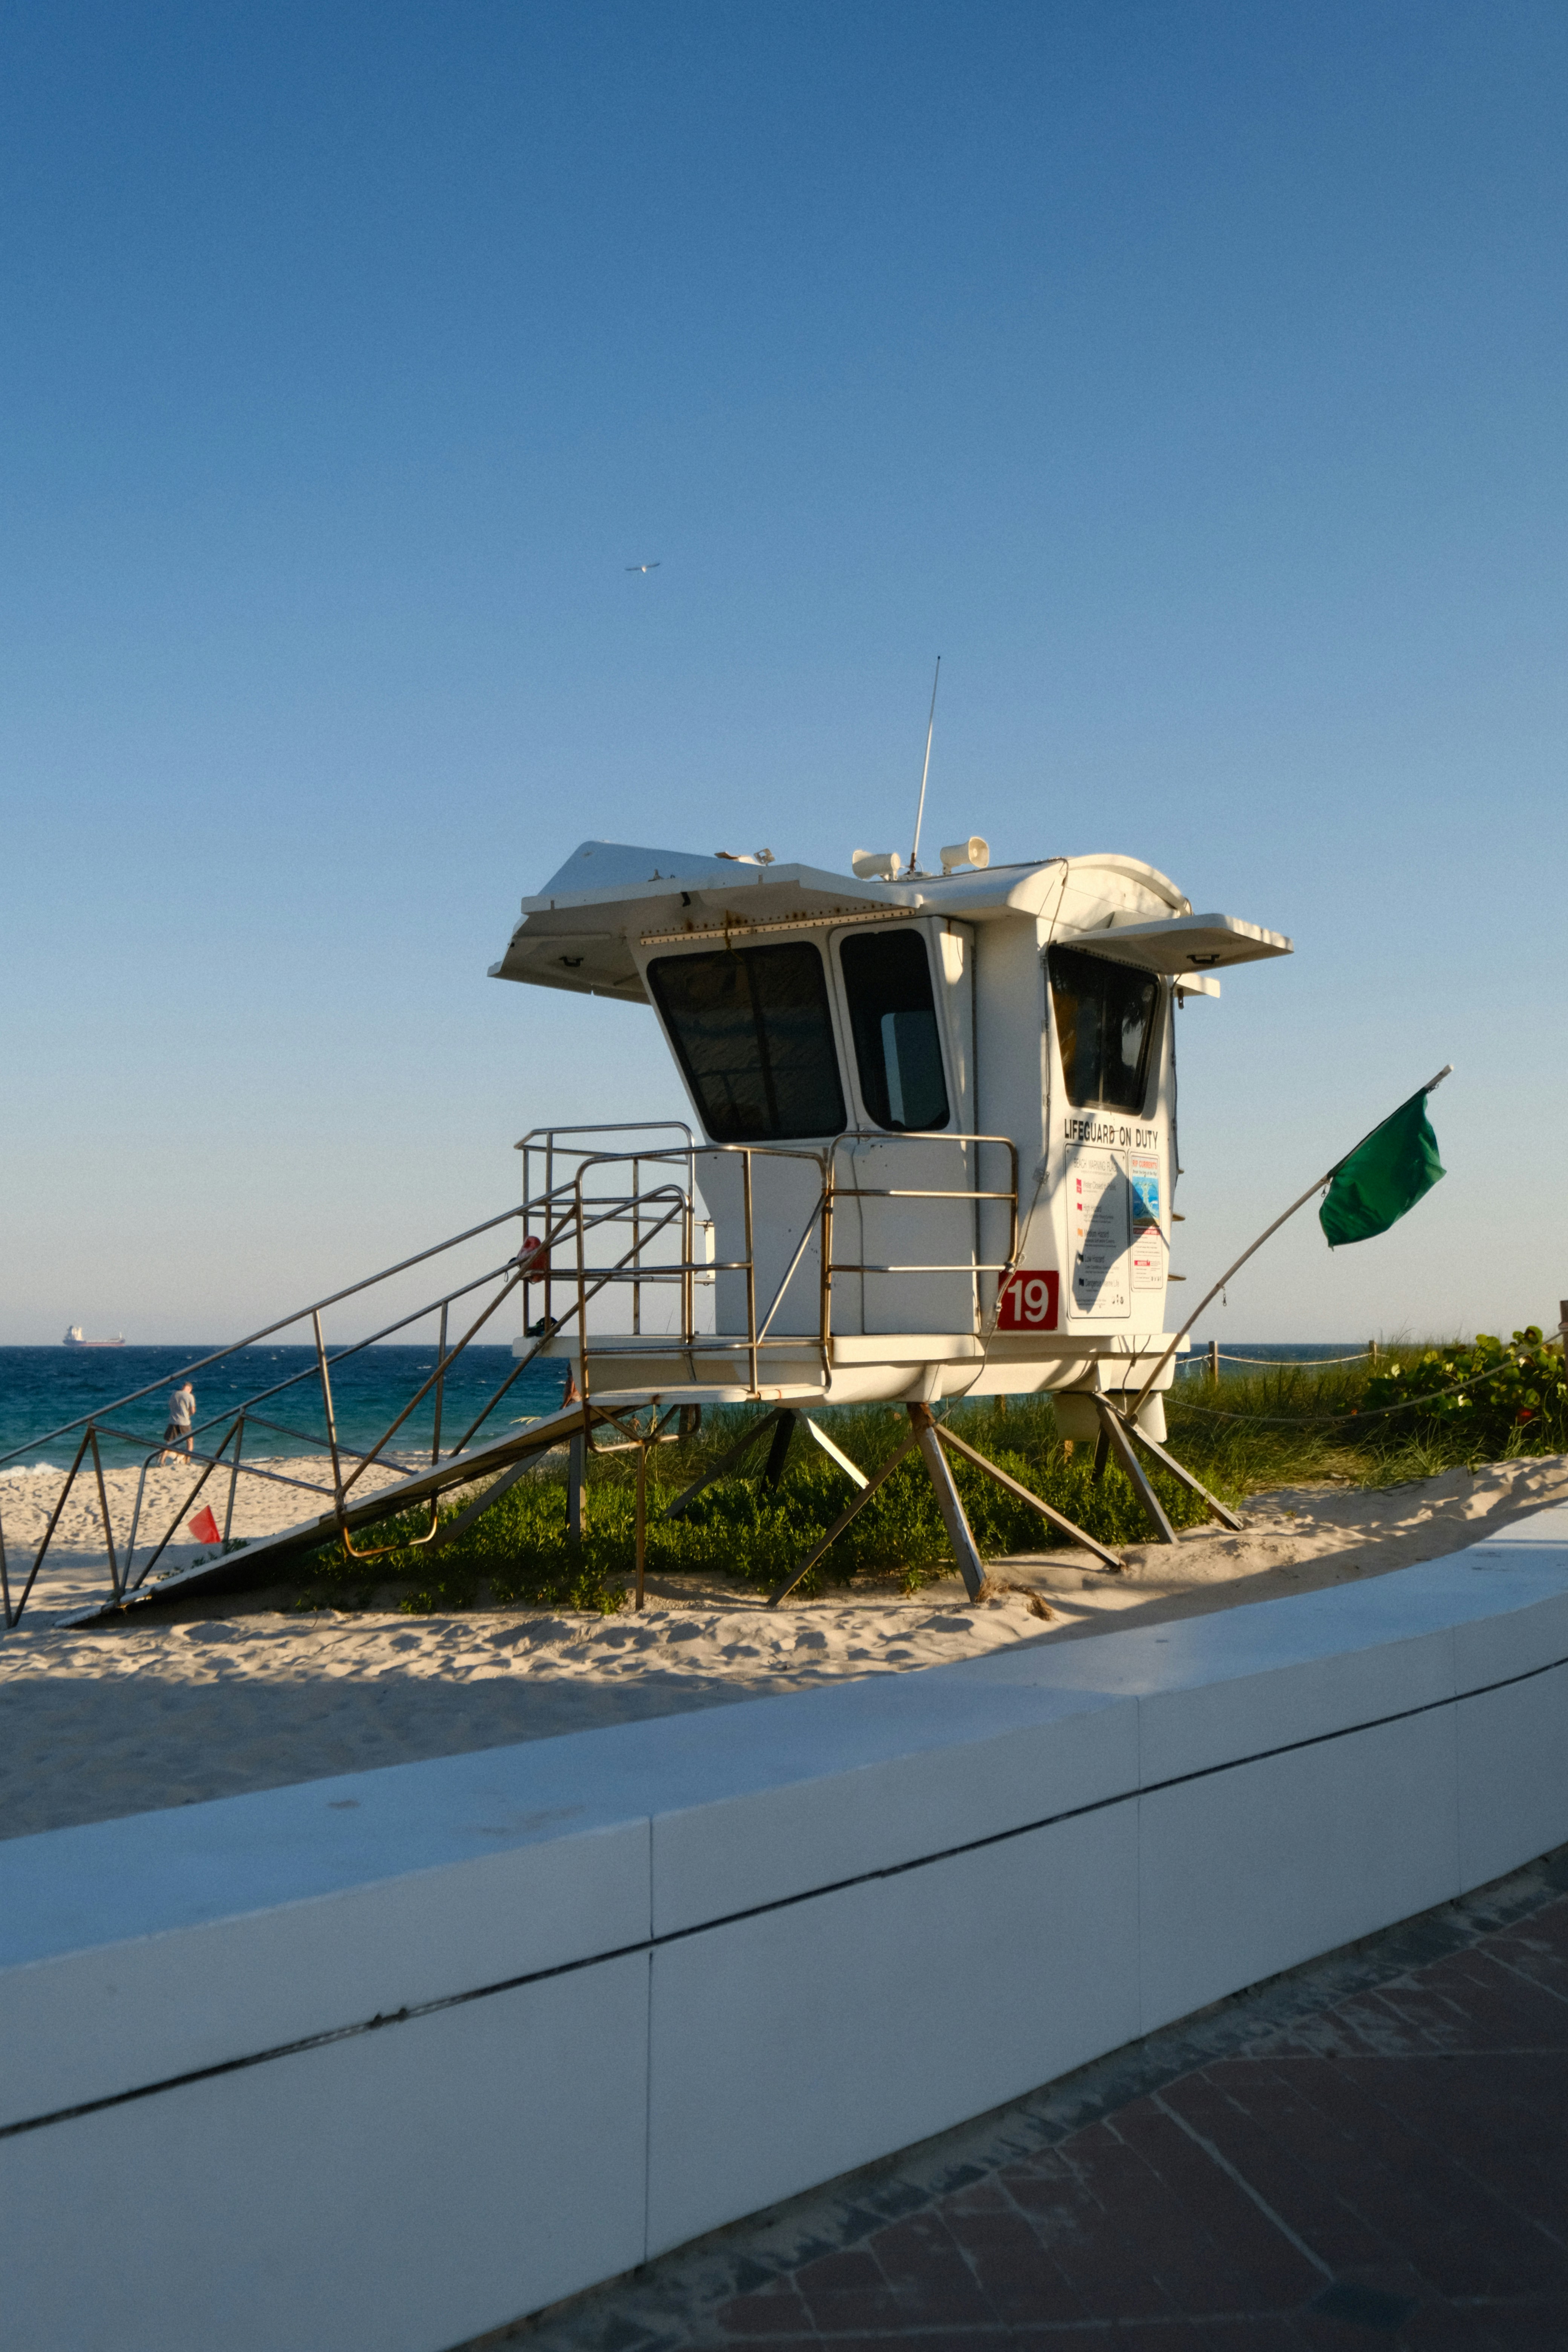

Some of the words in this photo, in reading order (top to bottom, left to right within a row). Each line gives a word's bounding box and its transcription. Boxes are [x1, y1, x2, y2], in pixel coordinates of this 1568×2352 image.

[1064, 1119, 1115, 1144] LIFEGUARD
[1119, 1127, 1131, 1146] ON
[1136, 1129, 1158, 1149] DUTY
[1074, 1158, 1087, 1168] BEACH
[1089, 1159, 1105, 1171] WARNING
[1139, 1160, 1157, 1169] CURRENTS
[1083, 1180, 1092, 1189] Water
[1093, 1181, 1103, 1190] Closed
[1008, 1279, 1049, 1322] 19
